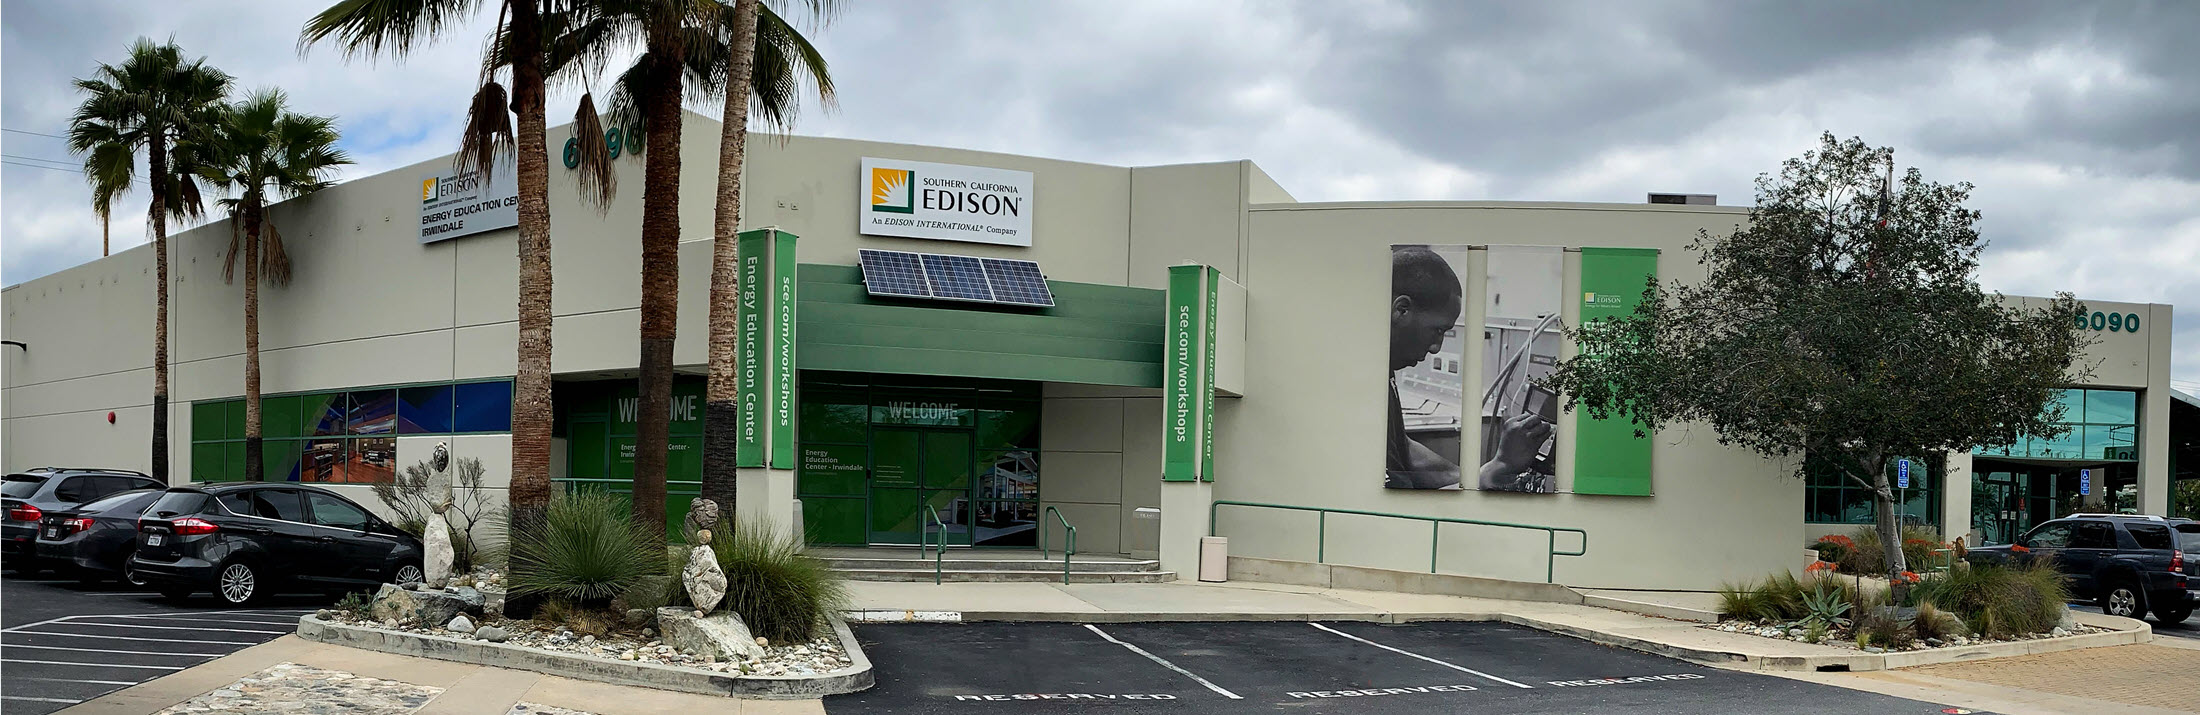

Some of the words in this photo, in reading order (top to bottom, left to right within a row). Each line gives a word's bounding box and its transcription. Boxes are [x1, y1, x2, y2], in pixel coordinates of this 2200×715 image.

[440, 177, 480, 197] EDISON
[923, 177, 967, 189] SOUTHERN
[970, 181, 1018, 194] CALIFORNIA
[422, 210, 452, 225] ENERGY
[454, 199, 501, 218] EDUCATION
[503, 195, 519, 207] CEN
[422, 220, 464, 237] IRWINDALE
[872, 217, 882, 225] An
[884, 218, 914, 227] EDISON
[986, 226, 1017, 236] Company
[744, 256, 757, 309] Energy
[2074, 311, 2140, 333] 6090
[746, 313, 757, 388] Education
[779, 276, 790, 426] sce.com/workshops
[1174, 305, 1189, 442] sce.com/workshops
[745, 393, 756, 443] Center
[889, 400, 959, 420] WELCOME
[621, 444, 636, 452] Energ
[805, 449, 828, 457] Energy
[1286, 684, 1478, 698] RESERVED
